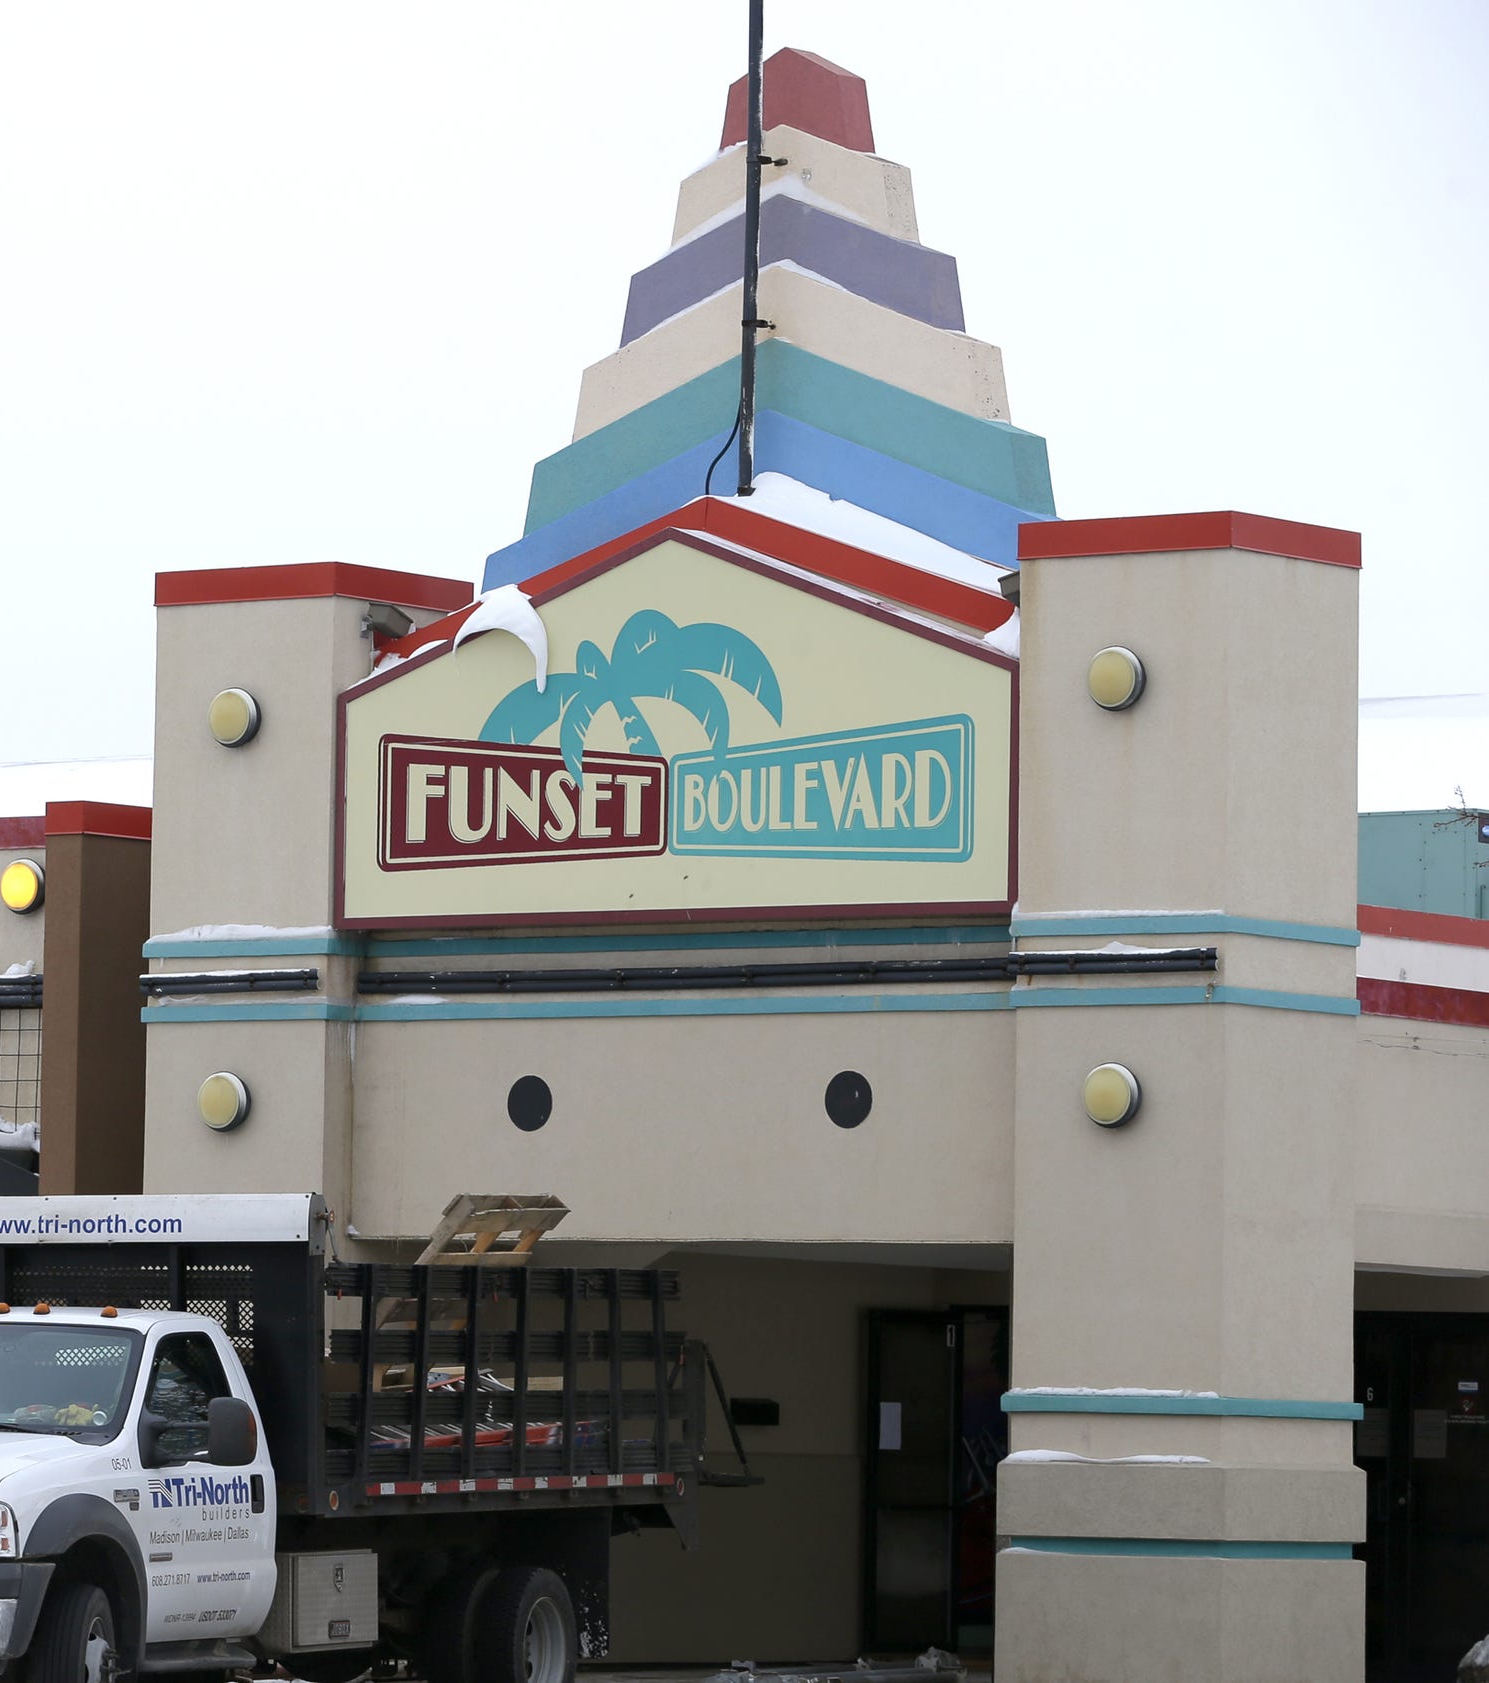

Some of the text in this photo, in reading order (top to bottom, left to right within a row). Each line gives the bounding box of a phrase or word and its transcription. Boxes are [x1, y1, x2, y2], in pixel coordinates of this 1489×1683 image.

[684, 749, 953, 833] BOULEVARD
[404, 763, 652, 844] FUNSET
[1367, 1387, 1374, 1401] 6
[112, 1458, 132, 1470] 05-01
[171, 1475, 250, 1507] Tri-North
[201, 1507, 250, 1520] builders
[150, 1526, 250, 1544] Madison Milwaukee Dallas
[197, 1569, 251, 1583] www.tri-north.com
